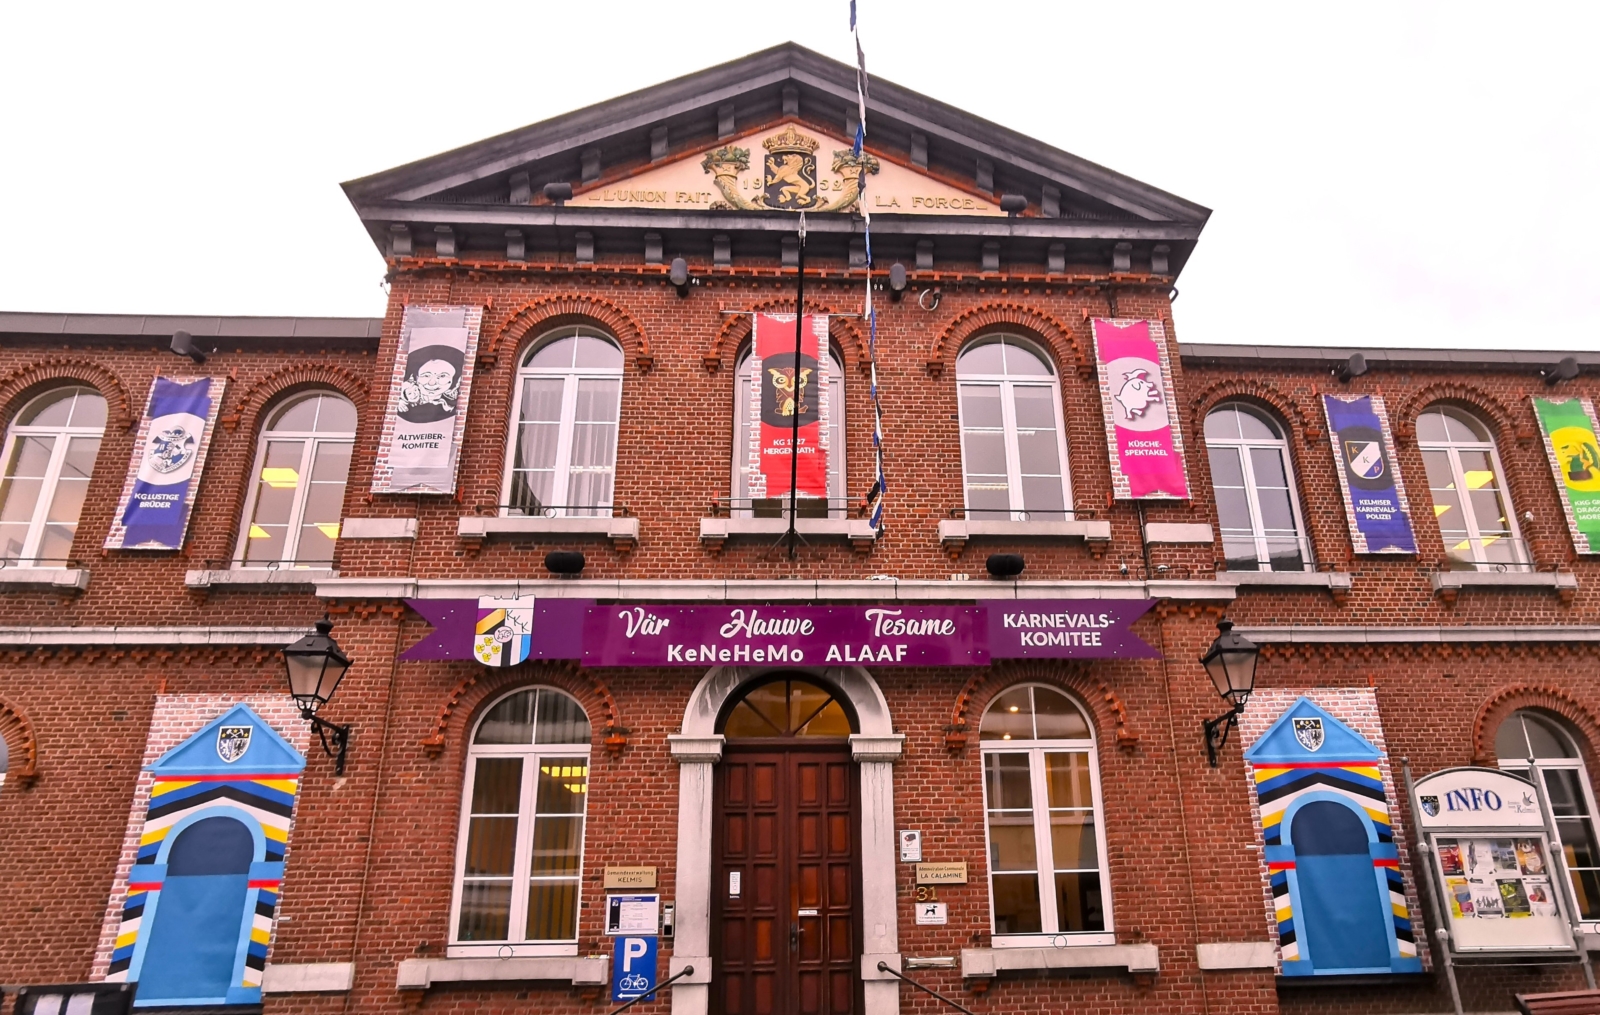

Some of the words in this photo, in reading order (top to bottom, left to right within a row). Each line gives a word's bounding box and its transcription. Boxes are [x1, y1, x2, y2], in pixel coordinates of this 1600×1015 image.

[742, 179, 762, 189] 19
[819, 180, 843, 191] 52
[675, 191, 712, 204] FAIT
[875, 196, 901, 208] LA
[912, 196, 975, 210] FORCE
[397, 433, 446, 441] ALTWEIBER-
[772, 438, 785, 446] KG
[786, 438, 806, 446] 127
[401, 441, 439, 449] KOMITEE
[1128, 439, 1162, 448] KÜSCHE-
[1124, 449, 1168, 457] SPEKTAKEL
[147, 493, 180, 501] LUSTIGE
[1574, 499, 1591, 507] KKG
[618, 607, 670, 638] Vär
[719, 608, 815, 638] Hauwe
[864, 608, 956, 637] Tesame
[1003, 613, 1115, 628] KARNEVALS-
[1020, 631, 1102, 647] KOMITEE
[666, 644, 805, 662] KeNeHeMo
[825, 644, 908, 662] ALAAF
[1443, 787, 1503, 812] INFO
[916, 886, 938, 901] 31
[623, 938, 648, 972] P
